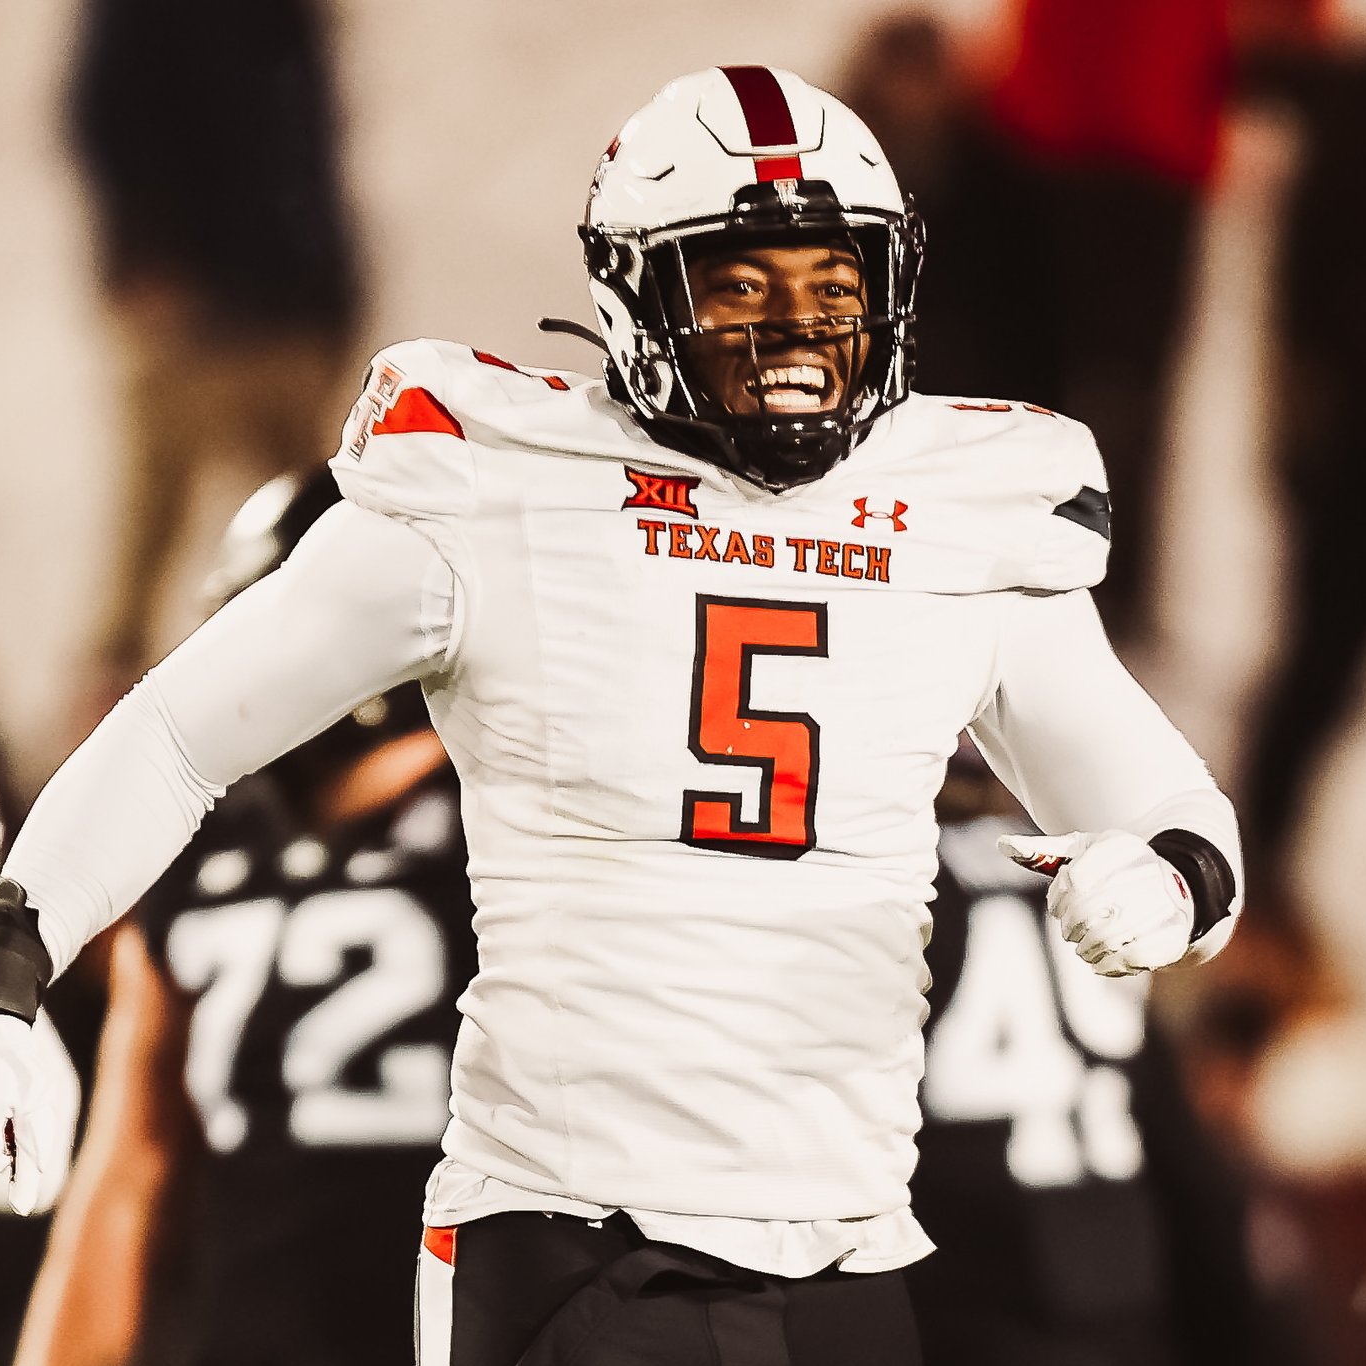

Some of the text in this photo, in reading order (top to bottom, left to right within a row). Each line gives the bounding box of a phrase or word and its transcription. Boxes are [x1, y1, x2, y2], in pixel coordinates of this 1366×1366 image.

[636, 518, 892, 583] TEXAS TECH
[679, 592, 829, 861] 5
[166, 888, 451, 1155] 72
